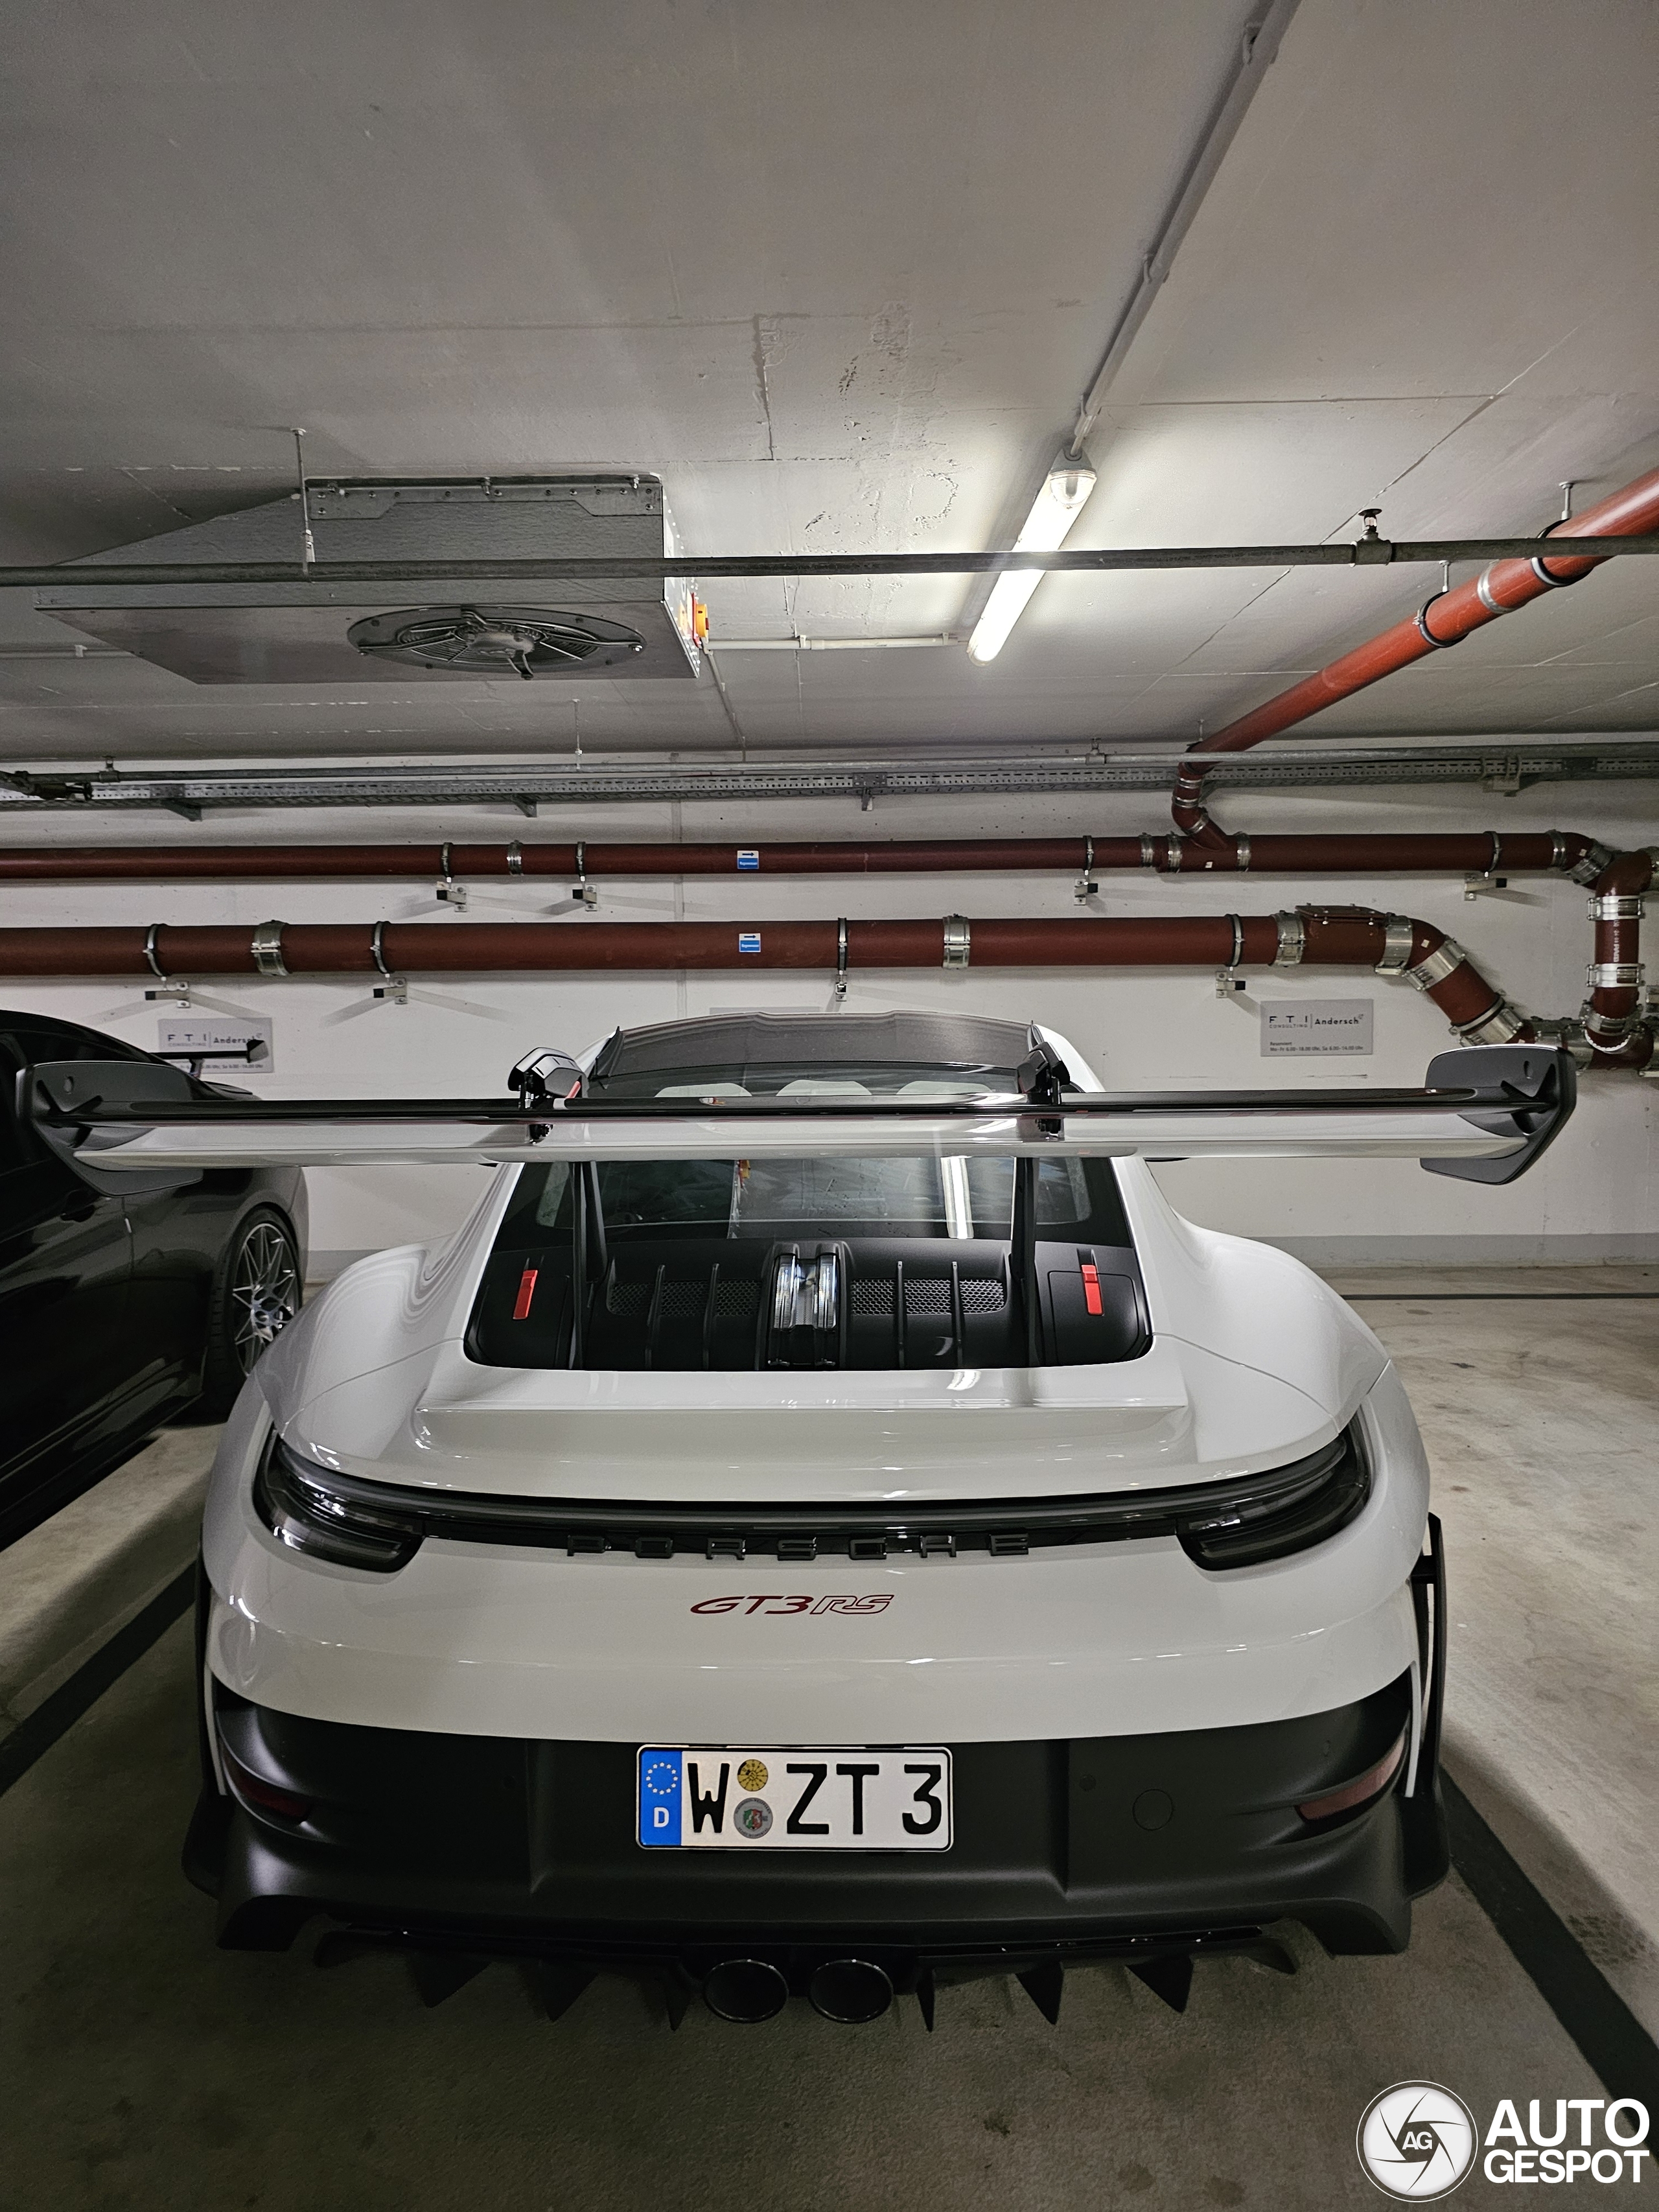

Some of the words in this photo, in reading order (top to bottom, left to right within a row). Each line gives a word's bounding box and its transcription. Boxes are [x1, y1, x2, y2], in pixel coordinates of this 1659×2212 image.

[567, 1533, 1028, 1560] PORSCHE
[653, 1807, 669, 1828] D
[687, 1763, 730, 1833] W
[786, 1764, 879, 1835] ZT
[902, 1764, 942, 1835] 3
